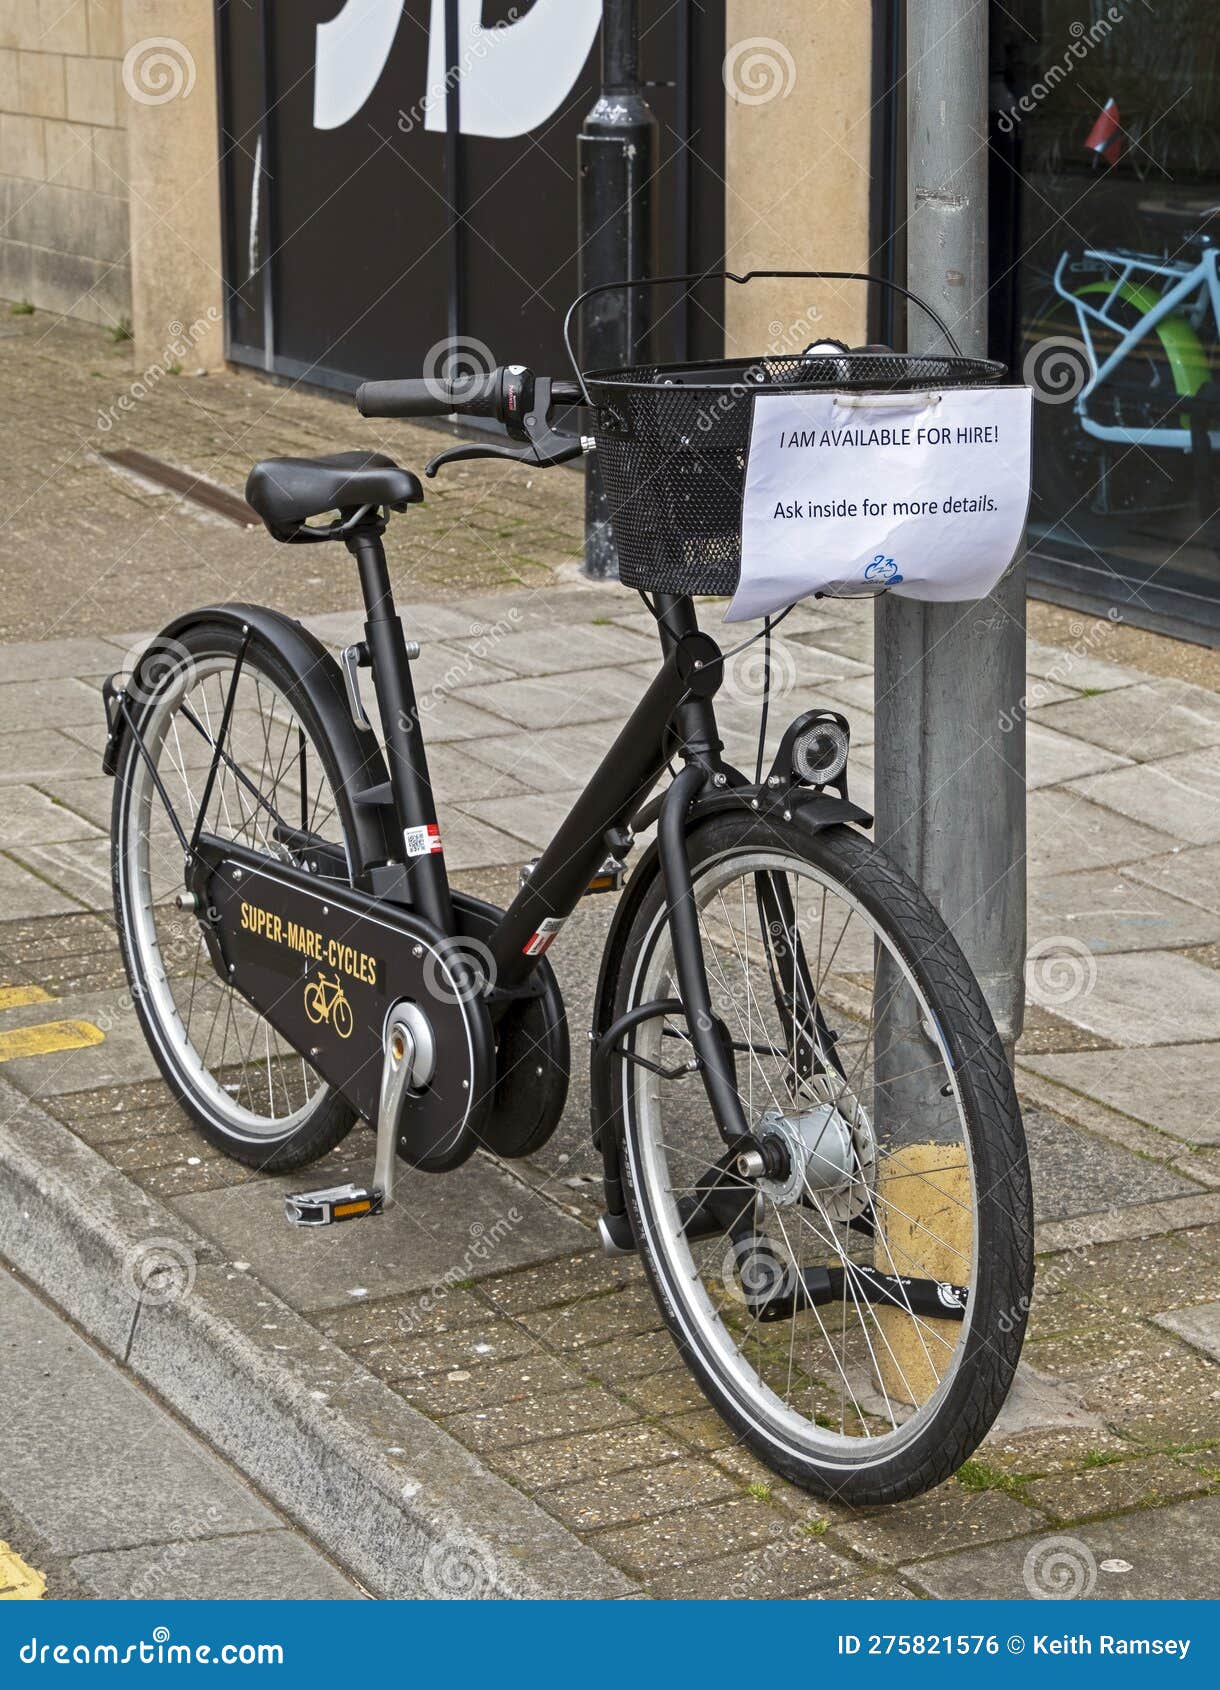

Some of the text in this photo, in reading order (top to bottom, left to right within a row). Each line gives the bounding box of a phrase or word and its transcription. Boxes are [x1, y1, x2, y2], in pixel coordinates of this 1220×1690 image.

[779, 425, 999, 449] I AM AVAILABLE FOR HIRE!
[773, 494, 999, 519] Ask inside for more details.
[240, 901, 377, 986] SUPER-MARE-CYCLES
